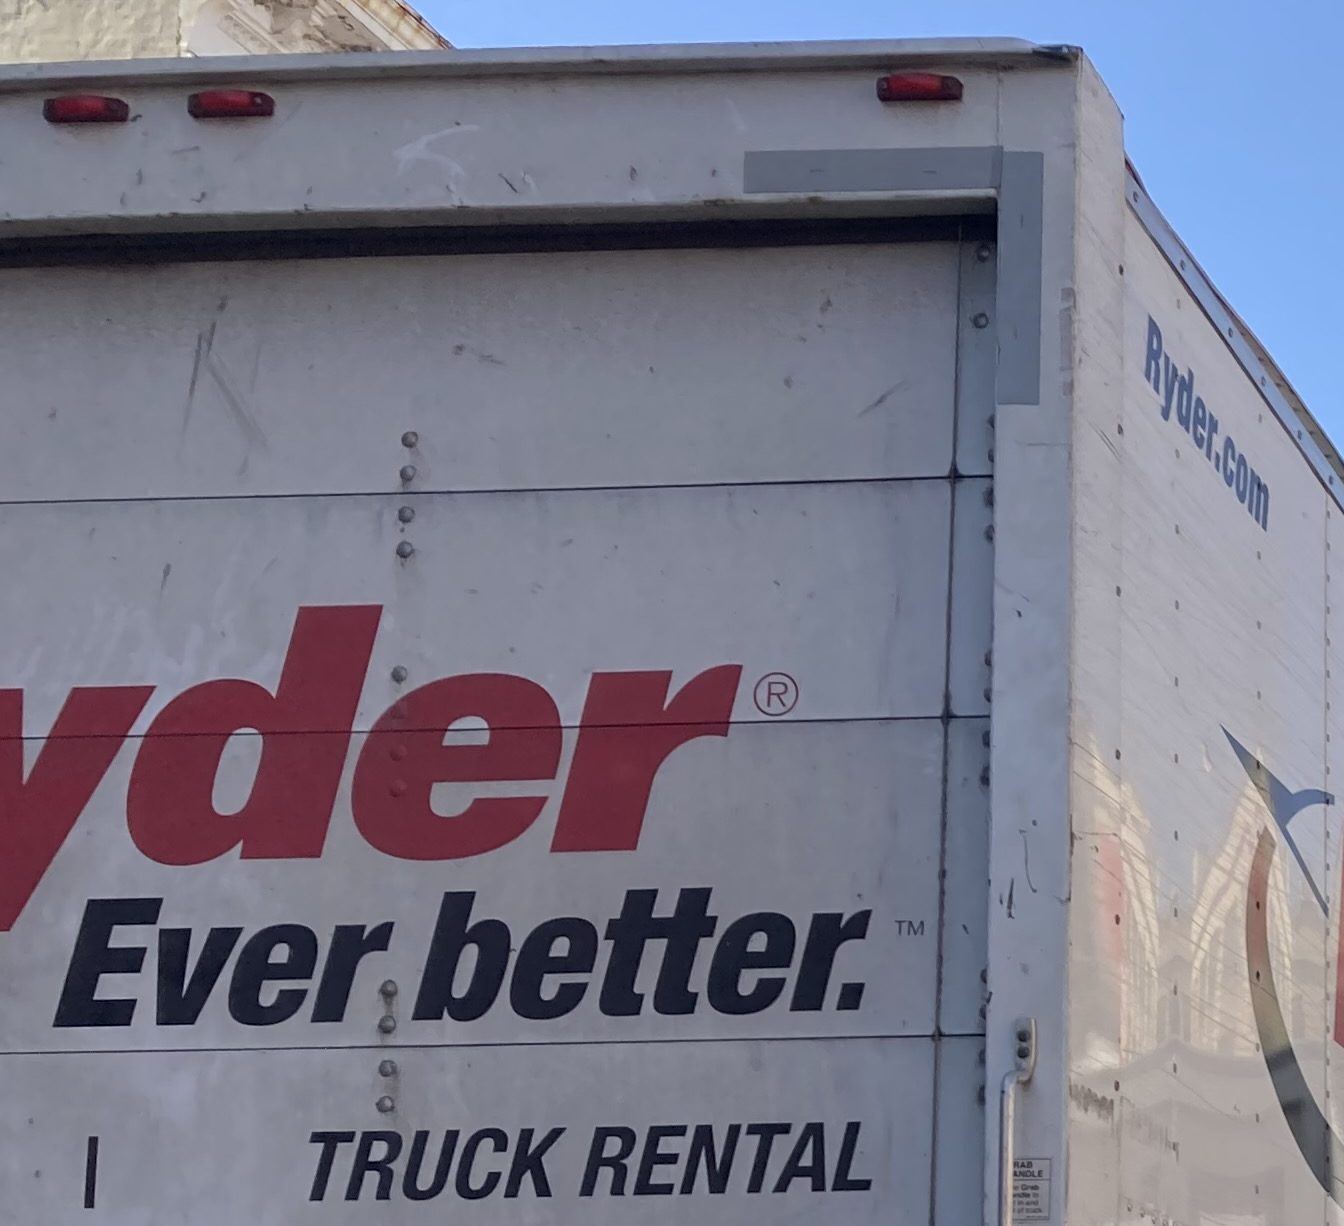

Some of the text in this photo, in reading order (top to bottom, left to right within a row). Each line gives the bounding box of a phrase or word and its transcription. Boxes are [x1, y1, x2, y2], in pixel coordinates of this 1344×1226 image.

[1144, 314, 1270, 532] Ryder.com
[52, 887, 873, 1029] Ever better.
[306, 1123, 874, 1201] TRUCK RENTAL
[1012, 1161, 1033, 1169] RAB
